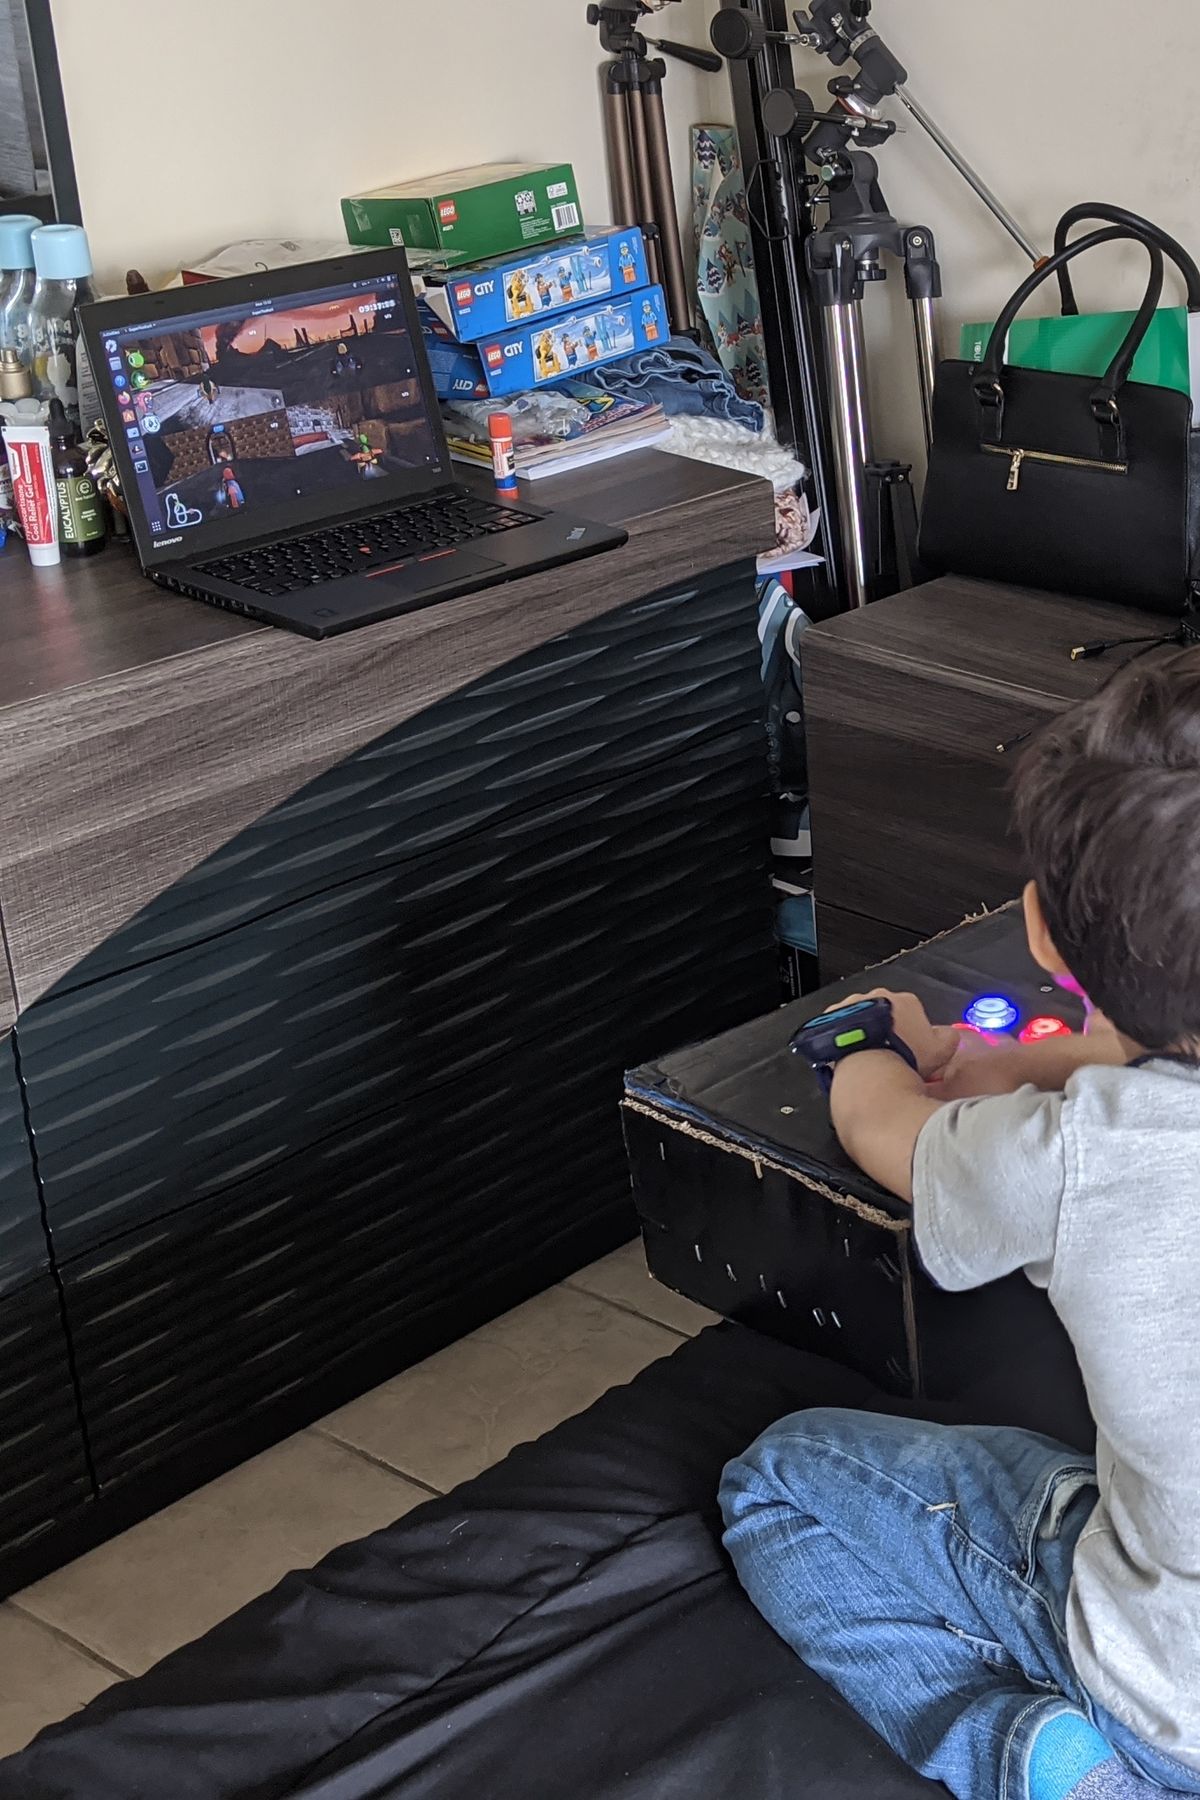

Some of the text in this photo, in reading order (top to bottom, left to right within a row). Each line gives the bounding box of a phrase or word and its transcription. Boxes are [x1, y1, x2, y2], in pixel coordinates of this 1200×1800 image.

[457, 280, 494, 301] LEGO CITY
[487, 341, 524, 362] LEGO CITY
[57, 481, 74, 539] EUCALYPTUS
[153, 535, 183, 548] lenovo
